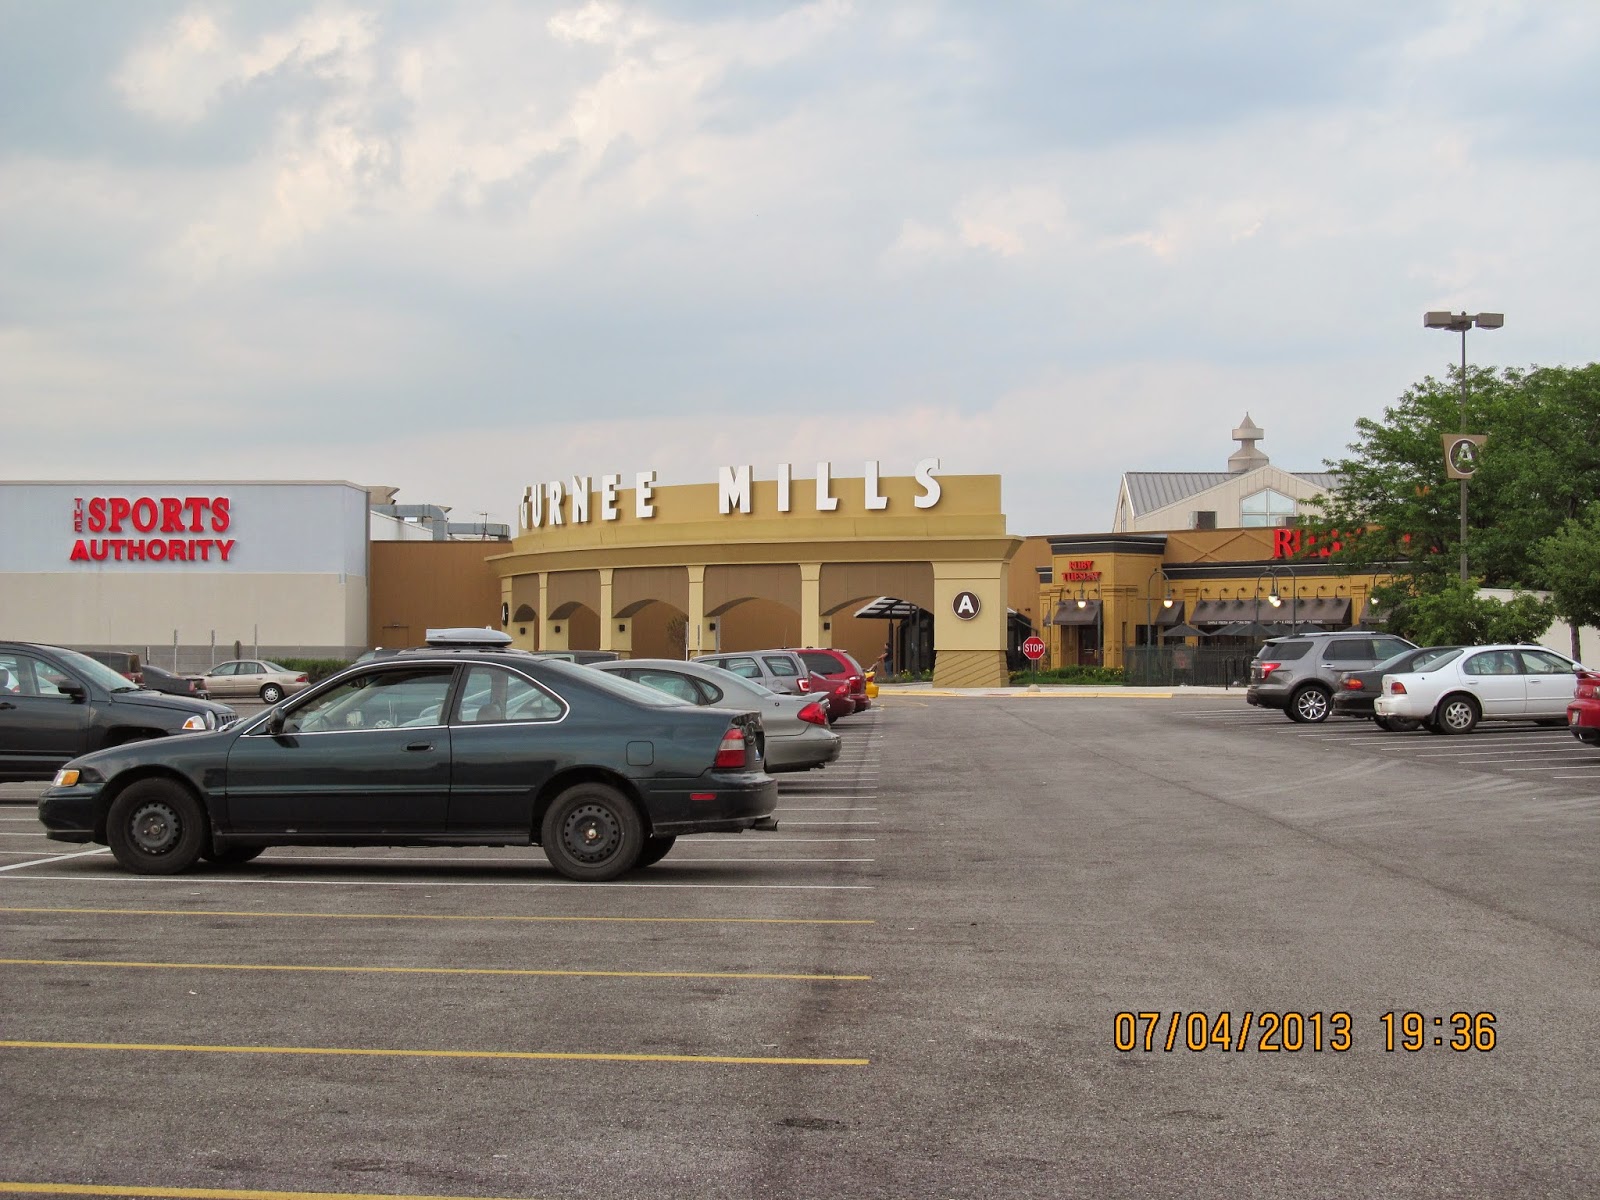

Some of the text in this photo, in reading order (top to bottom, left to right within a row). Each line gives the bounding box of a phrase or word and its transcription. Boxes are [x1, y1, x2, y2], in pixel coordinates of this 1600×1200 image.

[1455, 443, 1475, 467] A
[519, 458, 941, 529] GURNEE MILLS
[74, 497, 230, 533] THE SPORTS
[70, 539, 235, 561] AUTHORITY
[1069, 560, 1093, 570] RUBY
[957, 594, 975, 614] A
[1024, 643, 1043, 652] STOP
